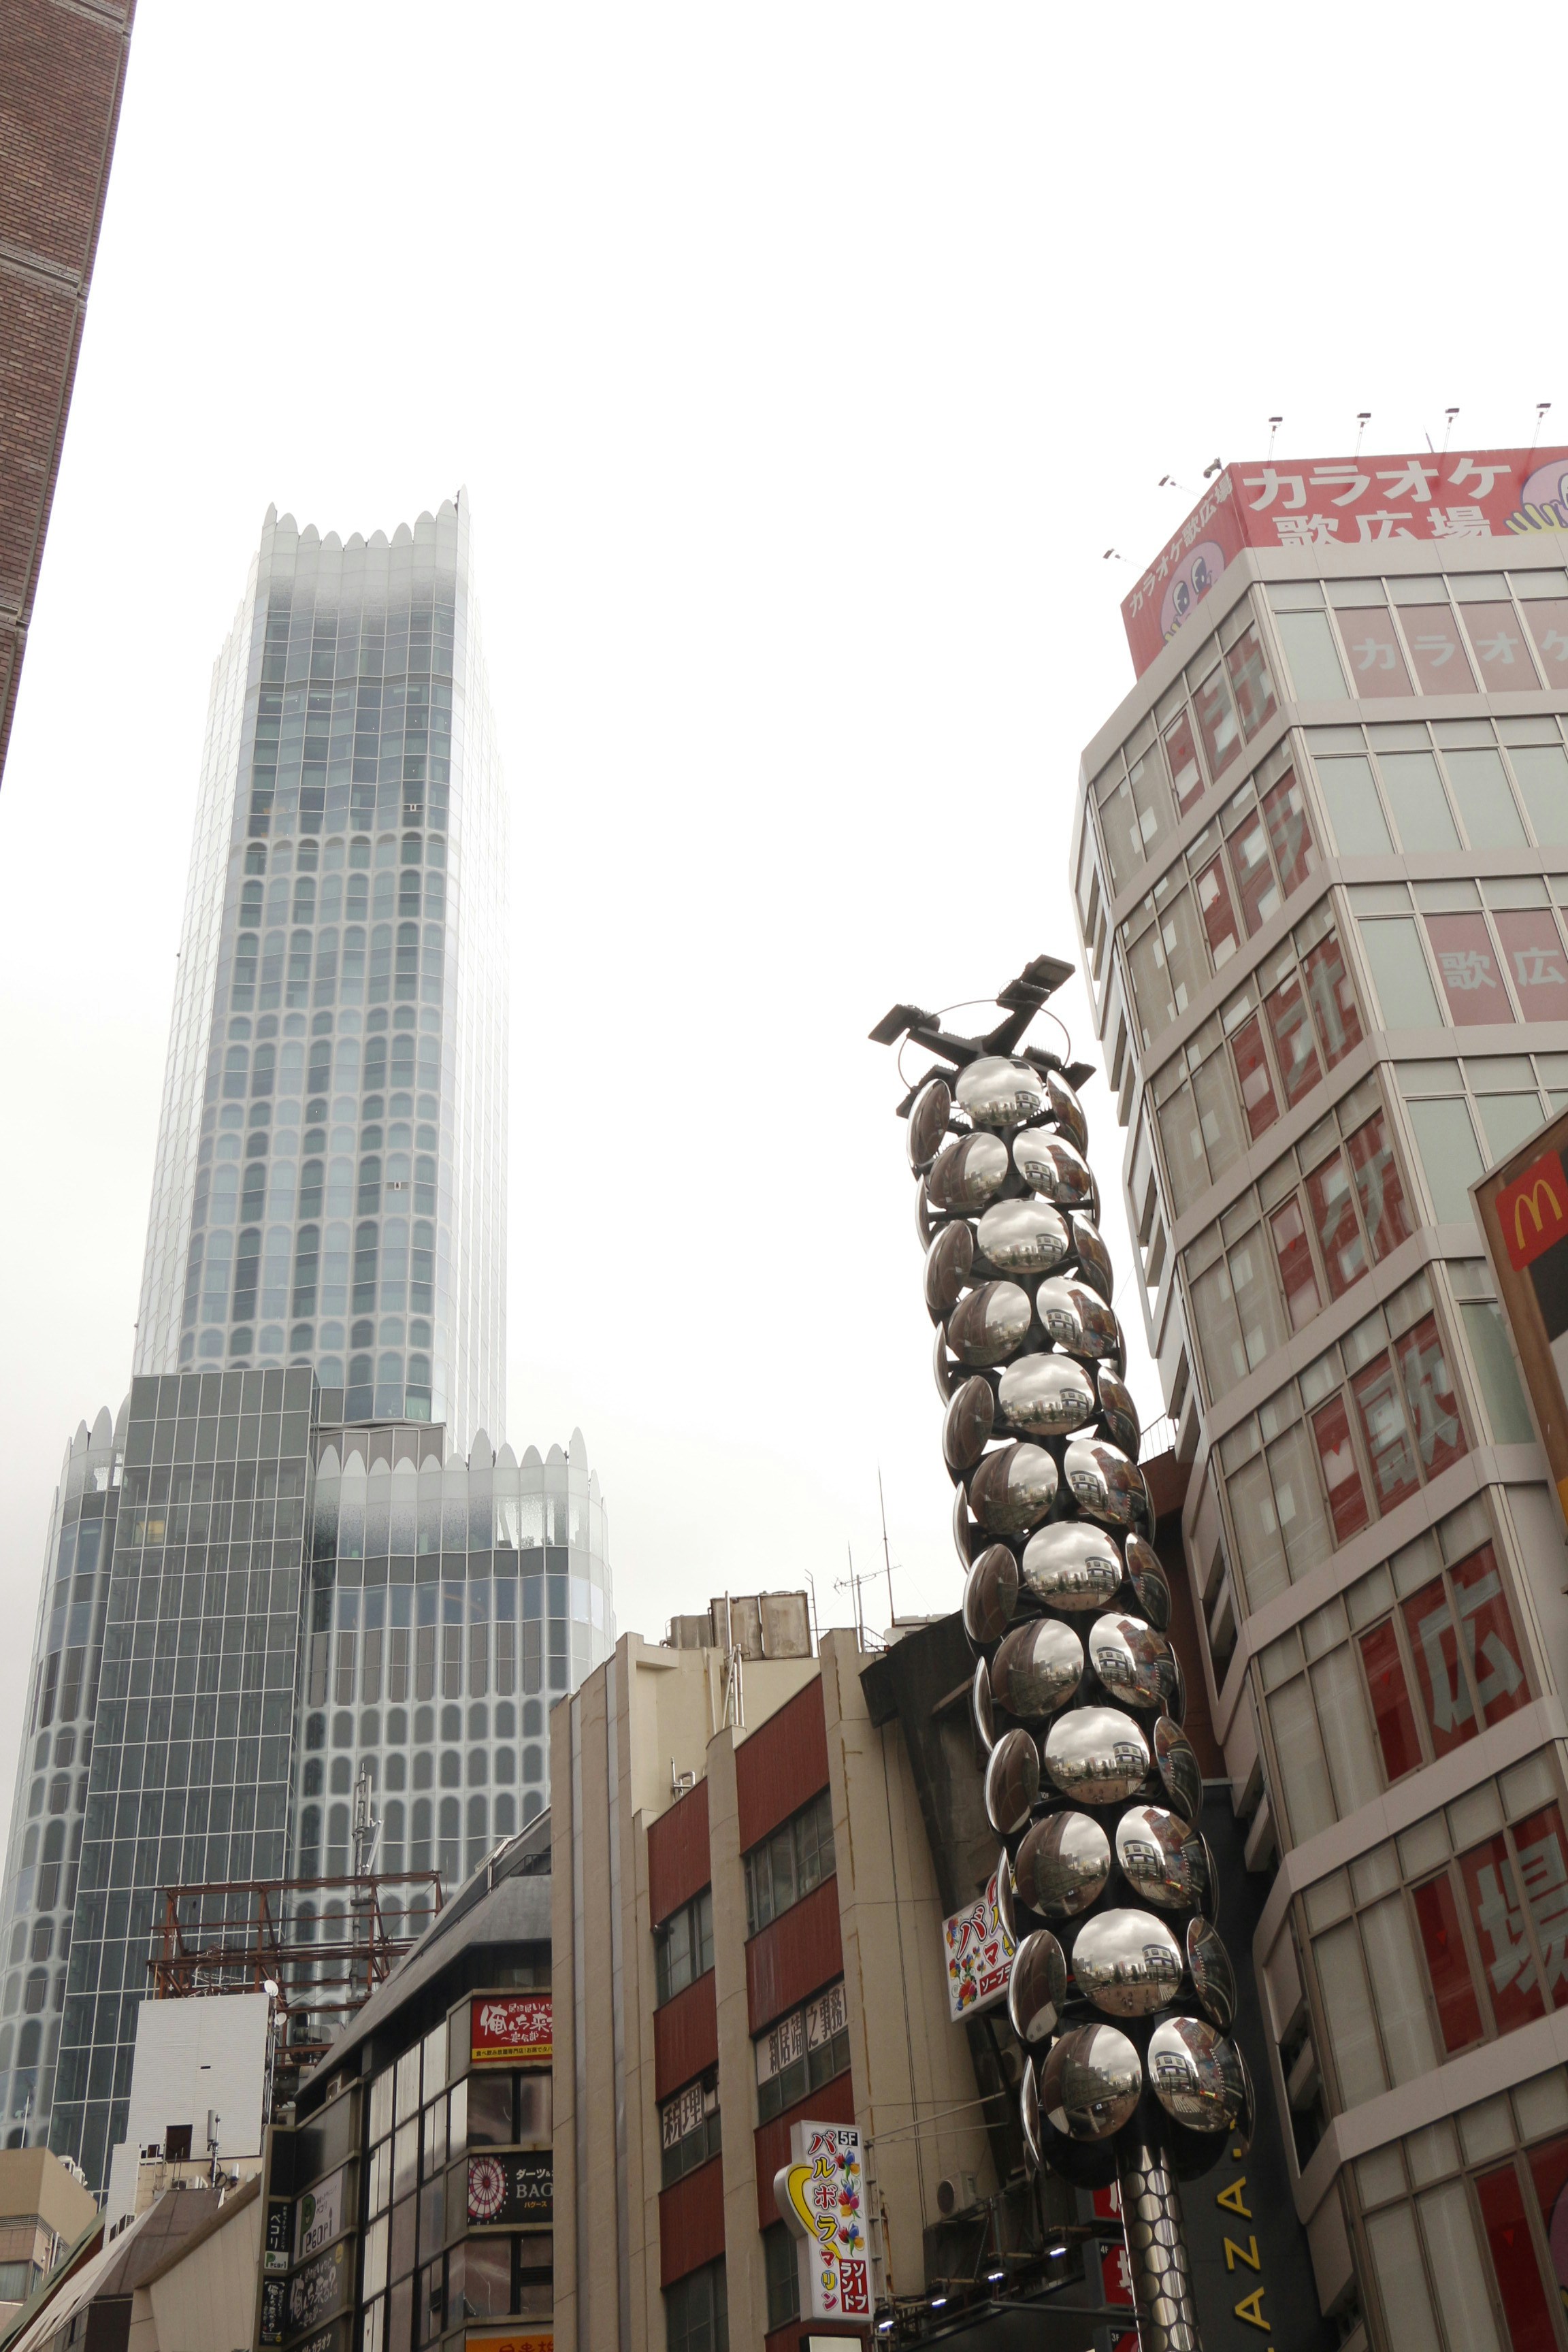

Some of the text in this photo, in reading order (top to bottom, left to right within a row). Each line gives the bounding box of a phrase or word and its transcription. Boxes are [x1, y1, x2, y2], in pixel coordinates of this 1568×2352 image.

[1243, 457, 1512, 512] カラオケ
[1272, 505, 1493, 546] 歌広場
[840, 2131, 857, 2146] 5F
[516, 2168, 553, 2180] ダーツ&
[1100, 2245, 1109, 2254] 4F
[1111, 2333, 1120, 2342] 3F
